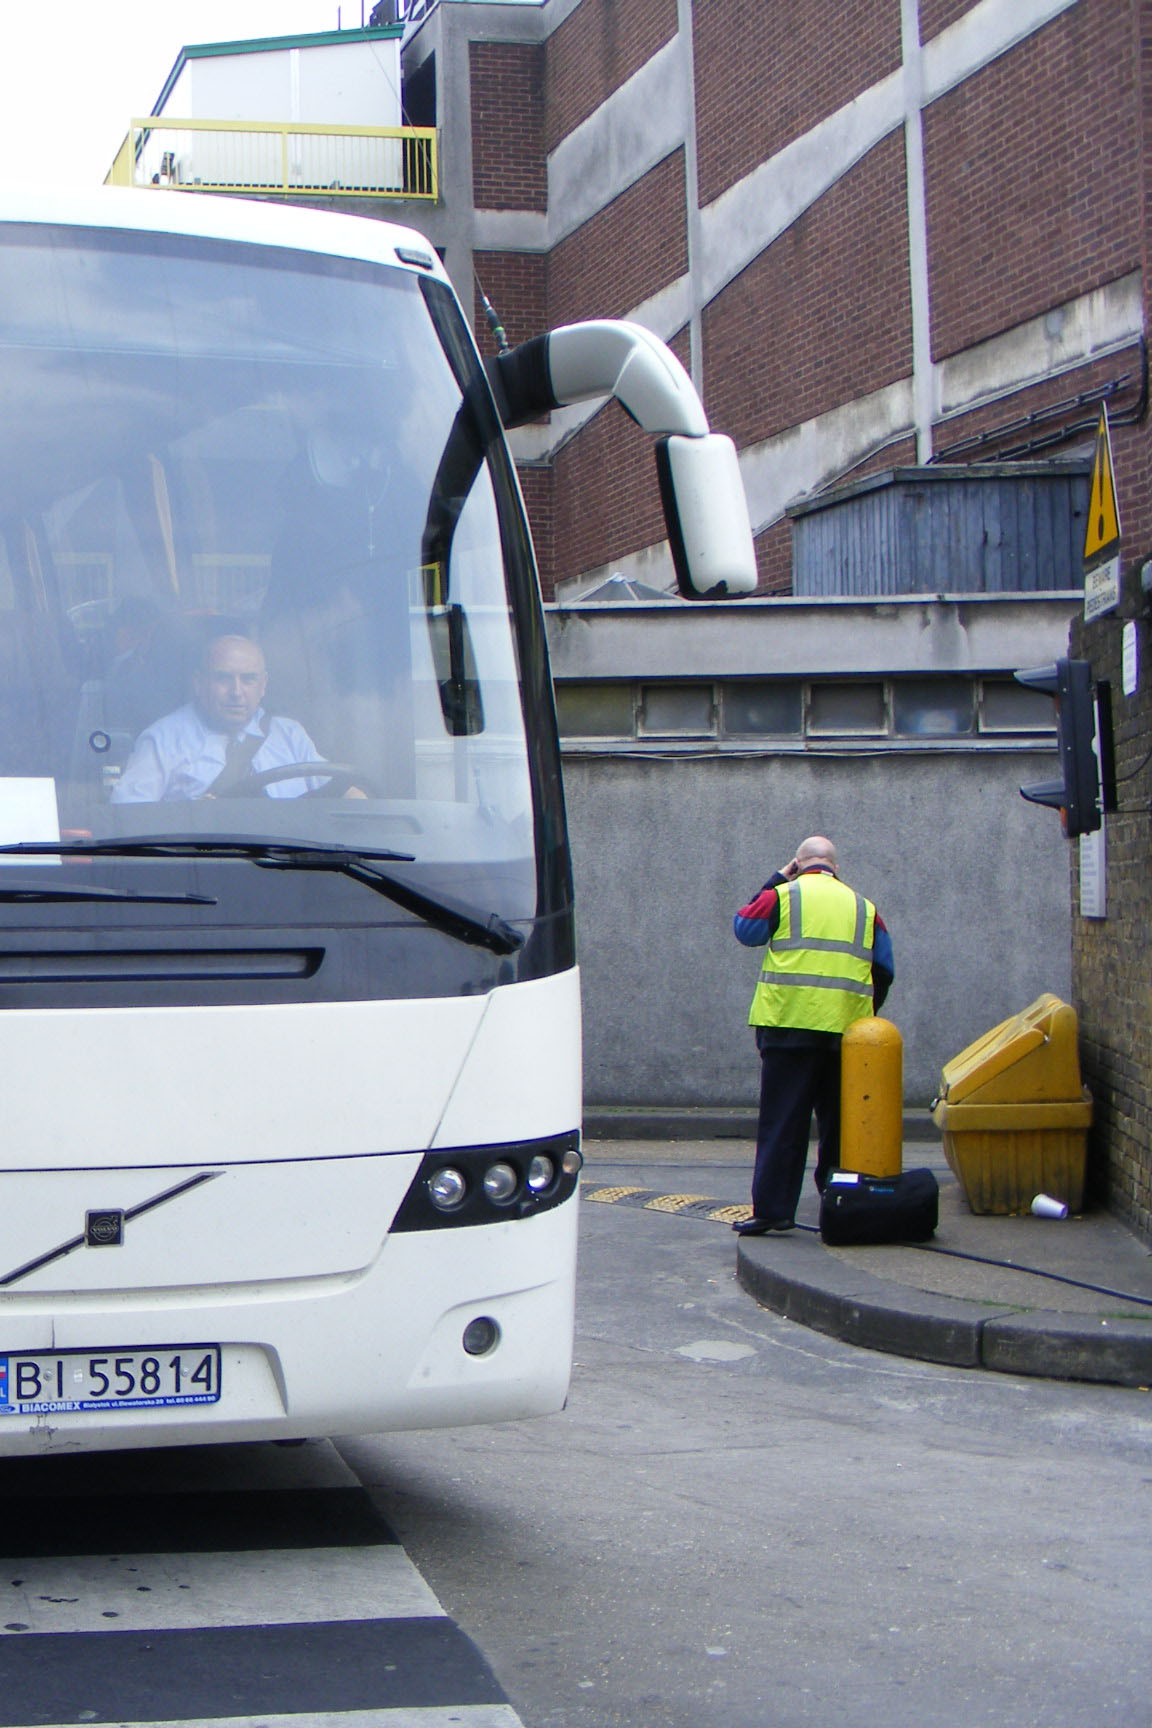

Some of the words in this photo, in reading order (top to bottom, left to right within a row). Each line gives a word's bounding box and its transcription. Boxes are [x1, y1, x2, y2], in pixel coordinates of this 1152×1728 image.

[16, 1360, 64, 1400] BI
[89, 1354, 214, 1397] 55814
[22, 1400, 80, 1413] BIACOMEX
